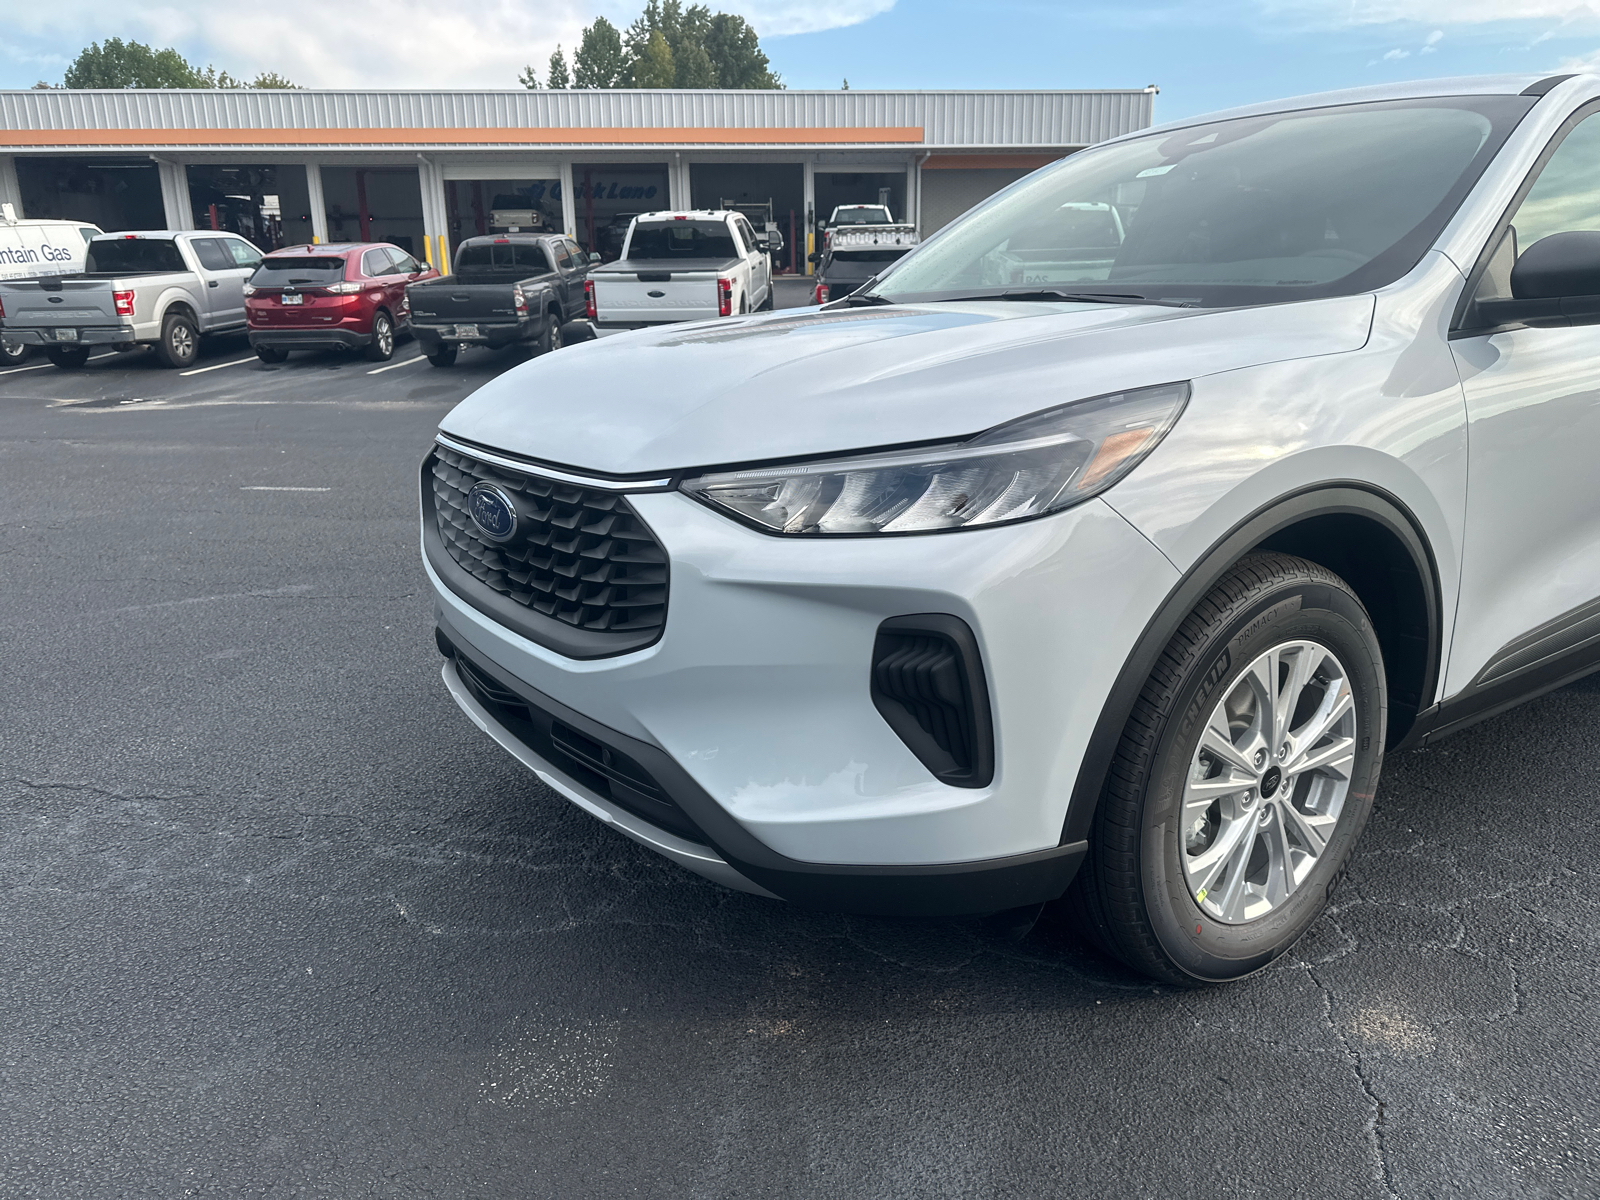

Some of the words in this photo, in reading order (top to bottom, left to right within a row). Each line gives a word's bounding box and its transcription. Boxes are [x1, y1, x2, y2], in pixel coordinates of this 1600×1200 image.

[550, 182, 606, 201] Qik
[607, 182, 657, 199] Lane
[0, 245, 40, 264] ntain
[41, 244, 72, 261] Gas
[1238, 608, 1280, 645] PRIMACY
[1169, 652, 1229, 770] MICHELIN
